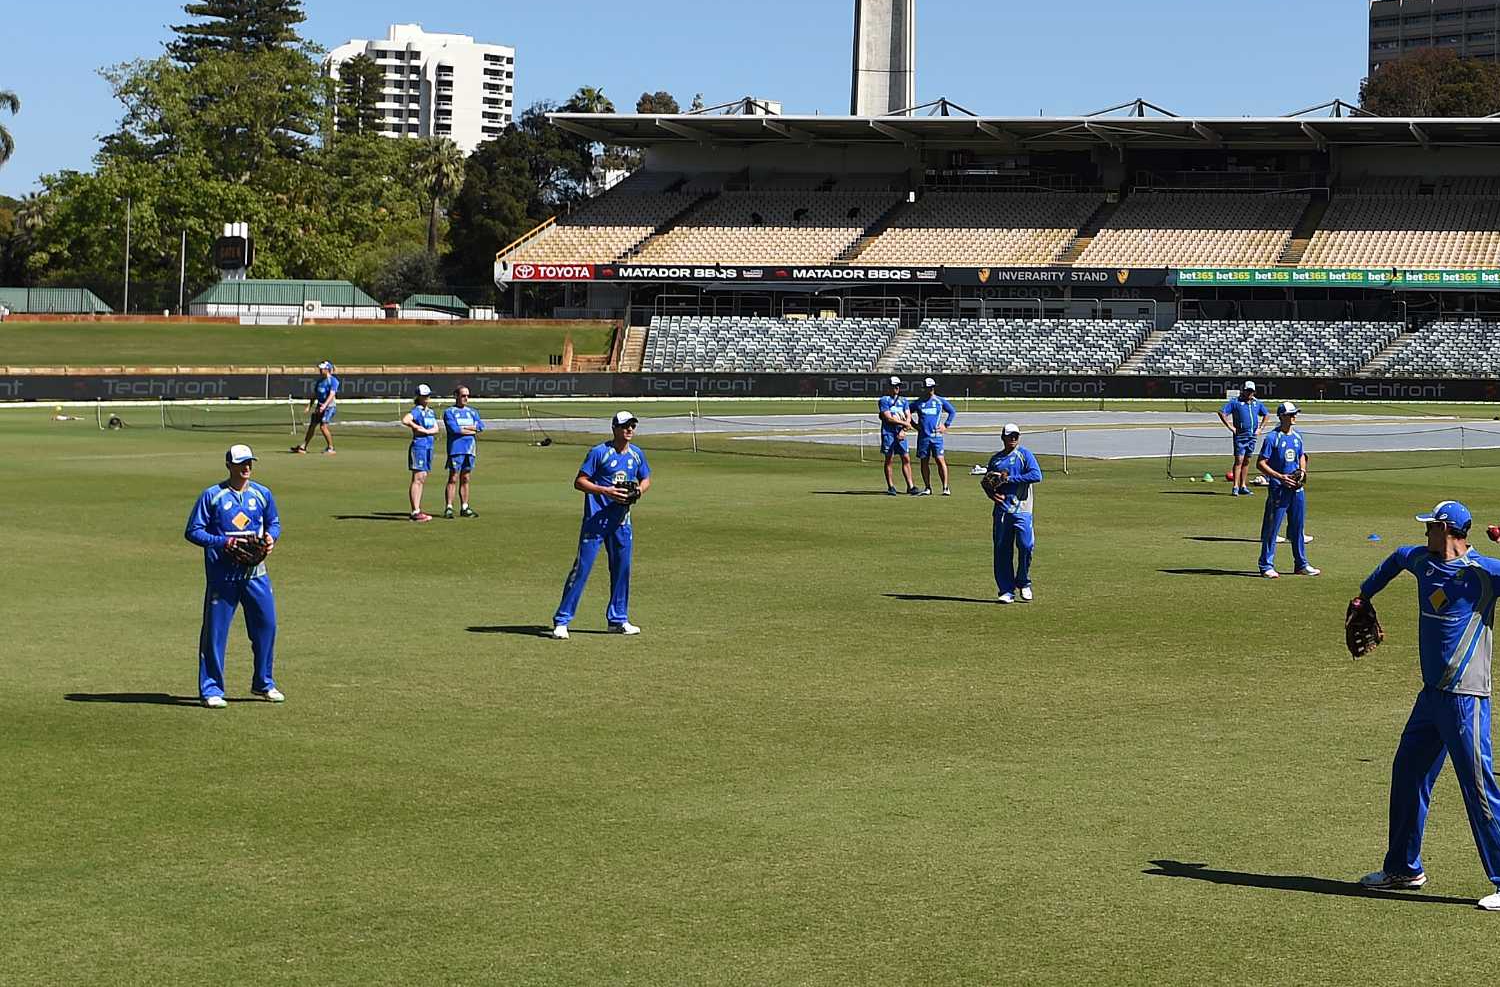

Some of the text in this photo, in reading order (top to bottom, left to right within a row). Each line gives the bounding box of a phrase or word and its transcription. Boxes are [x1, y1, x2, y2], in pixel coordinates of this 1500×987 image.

[539, 268, 590, 278] TOYOTA
[619, 268, 690, 278] MATADOR
[694, 268, 737, 279] BBQS
[793, 269, 864, 279] MATADOR
[867, 269, 911, 280] BBQS
[998, 271, 1108, 281] INVERARITY STAND
[1179, 270, 1213, 280] bet365
[1216, 270, 1250, 280] bet365
[1255, 270, 1289, 280] bet365
[1293, 271, 1327, 280] bet365
[1329, 271, 1363, 281] bet365
[1406, 272, 1440, 282] bet365
[1443, 272, 1477, 282] bet365
[975, 287, 1051, 298] HOT FOOD
[1112, 287, 1141, 299] BAR
[103, 378, 227, 395] Techfront
[300, 377, 412, 394] Thfront
[476, 377, 580, 391] Techfront
[642, 377, 756, 392] Techfront
[999, 378, 1106, 394] Techfront
[1339, 381, 1445, 398] Techfront
